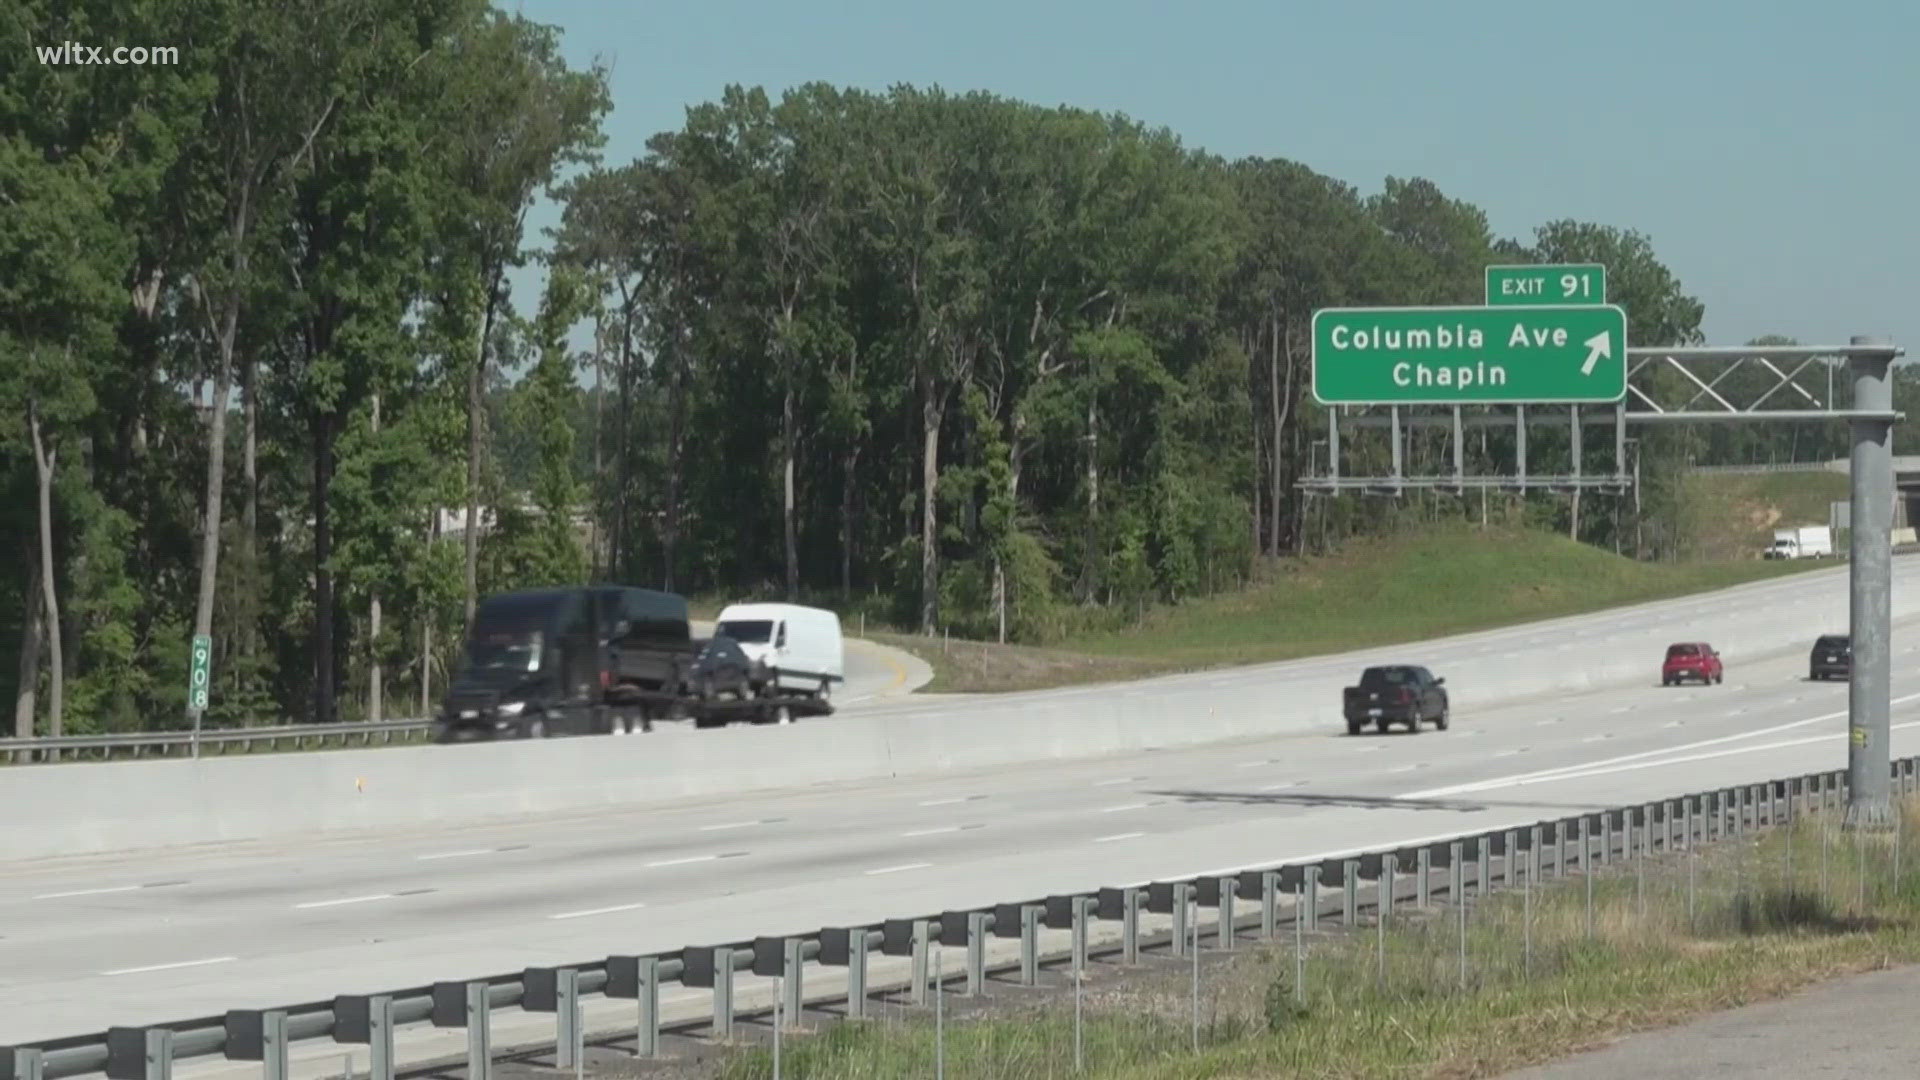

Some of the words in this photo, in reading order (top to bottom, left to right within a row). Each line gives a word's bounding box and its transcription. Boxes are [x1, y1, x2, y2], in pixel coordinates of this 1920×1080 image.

[1502, 278, 1545, 295] EXIT
[1560, 274, 1591, 297] 91
[1331, 324, 1484, 350] Columbia
[1508, 323, 1568, 348] Ave
[1393, 361, 1507, 390] Chapin
